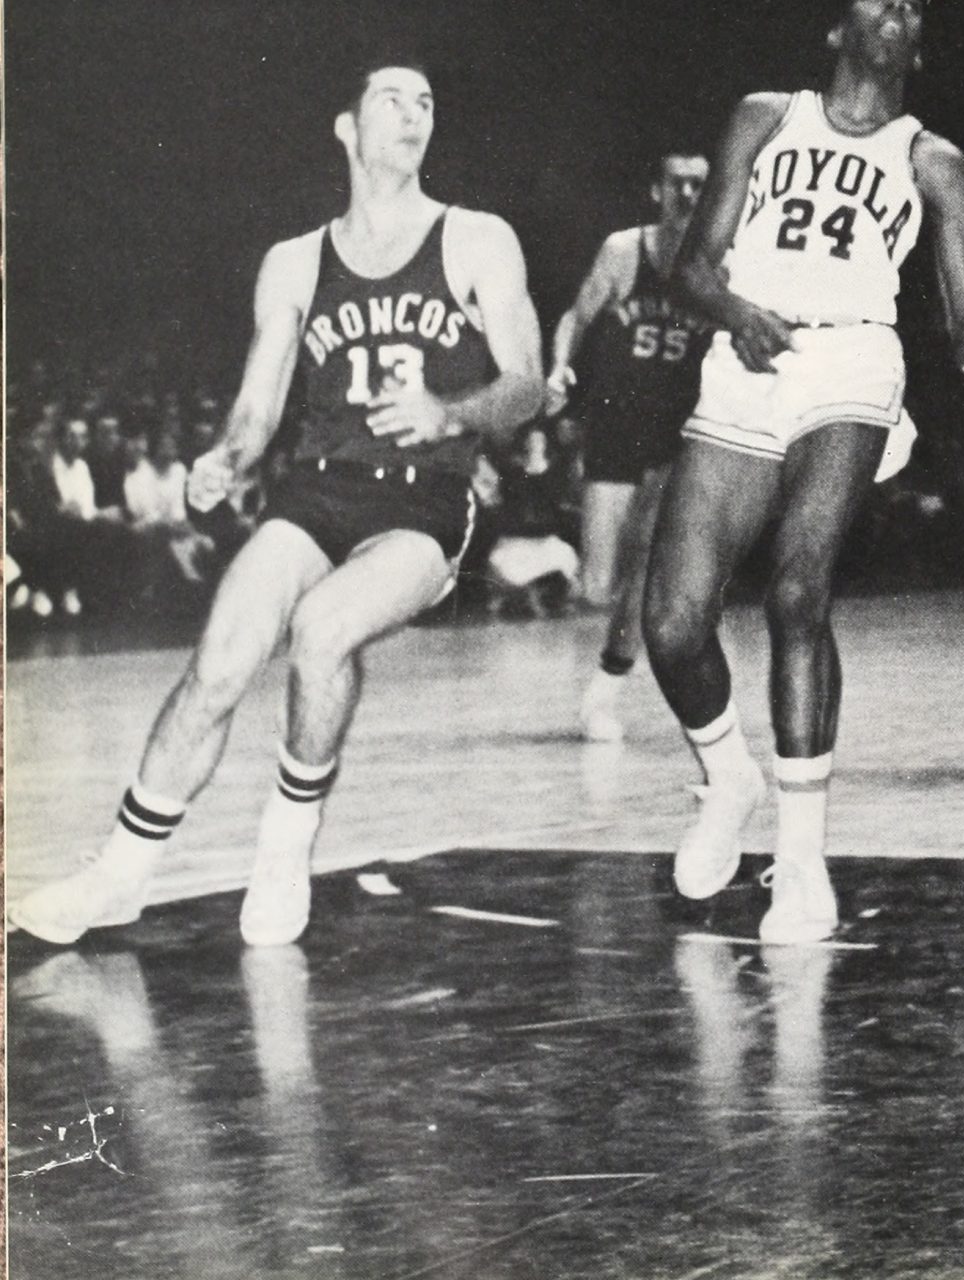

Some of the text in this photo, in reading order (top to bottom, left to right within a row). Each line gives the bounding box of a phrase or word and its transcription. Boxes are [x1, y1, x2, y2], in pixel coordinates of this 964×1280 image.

[776, 197, 858, 261] 24
[304, 292, 467, 367] BRONCOS
[632, 324, 689, 361] 55
[346, 343, 425, 405] 13
